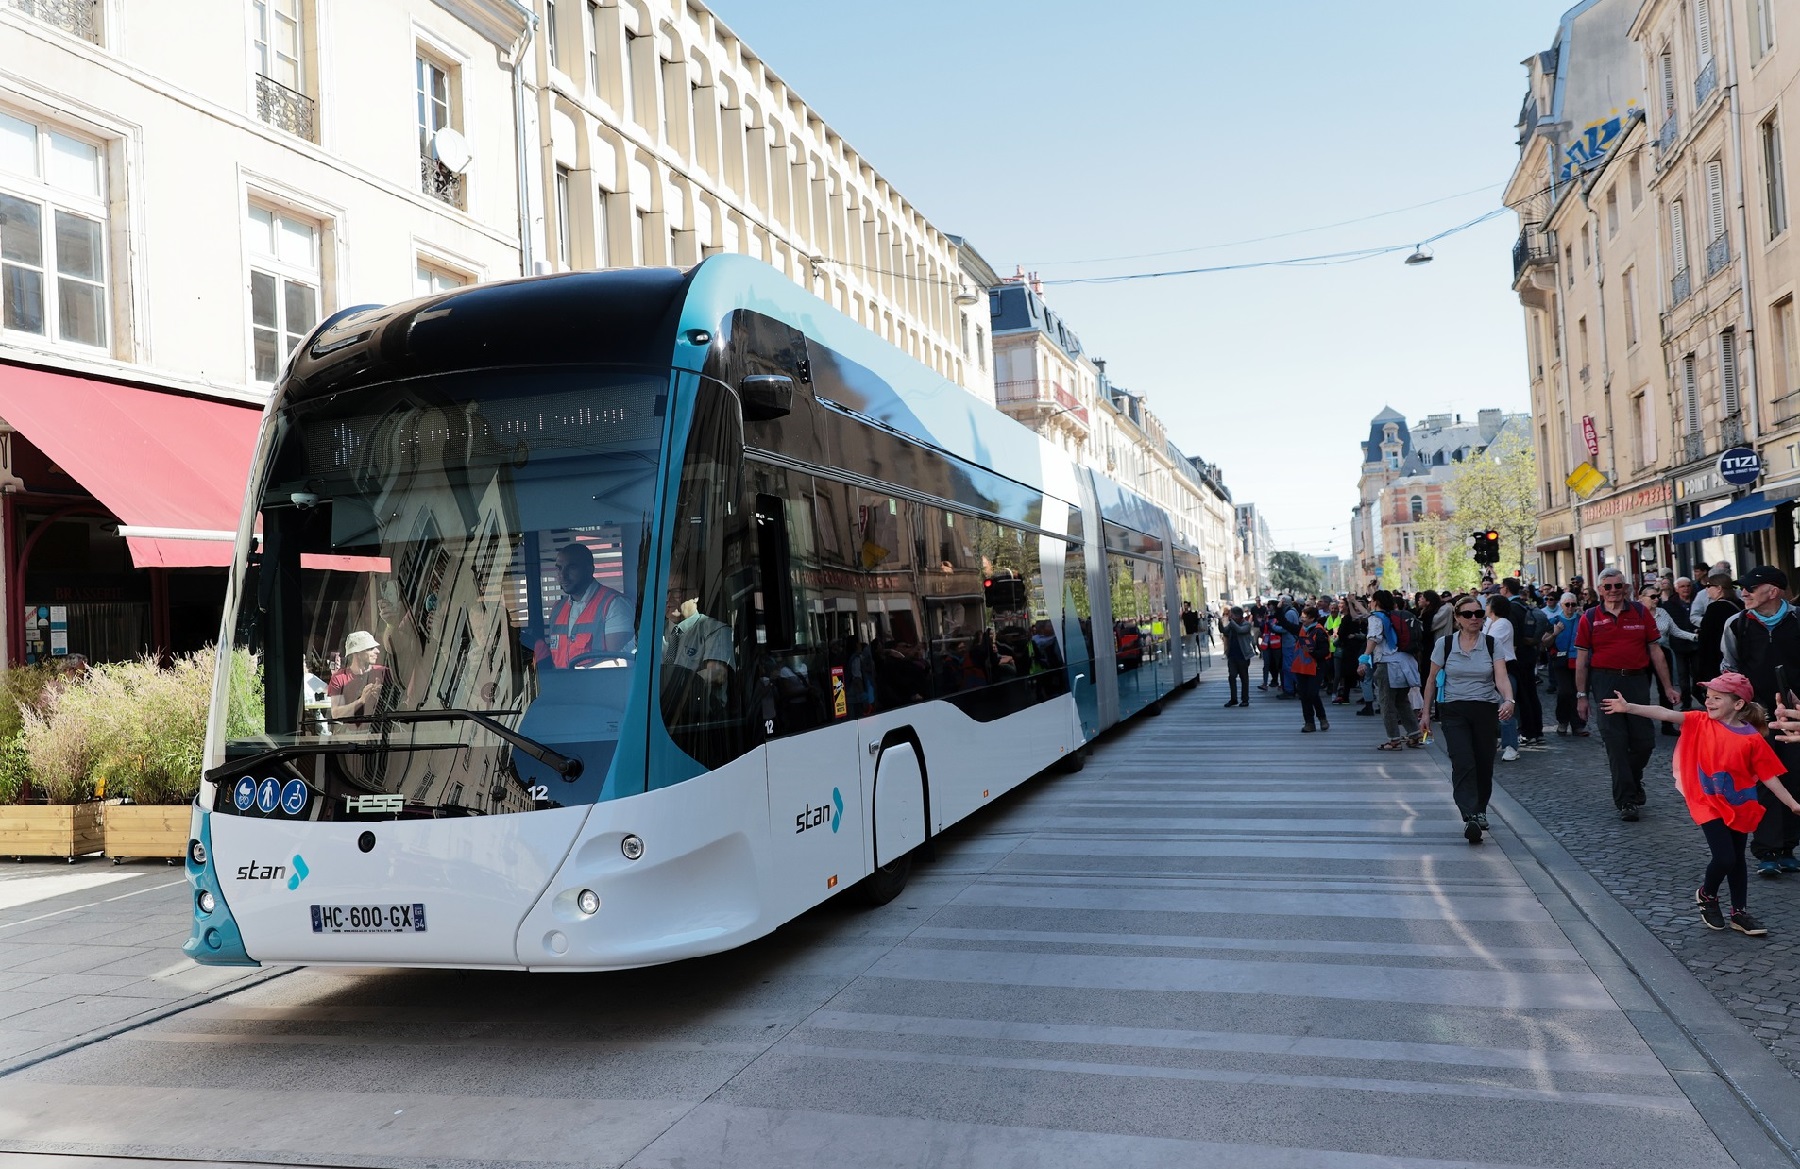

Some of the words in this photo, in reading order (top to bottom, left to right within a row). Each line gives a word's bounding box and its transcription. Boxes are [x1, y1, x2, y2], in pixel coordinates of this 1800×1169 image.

[1583, 416, 1598, 455] TABAC
[1723, 455, 1758, 469] TIZI
[1684, 475, 1709, 496] POINT
[1712, 525, 1723, 536] TIZI
[765, 720, 774, 734] 12
[528, 785, 549, 801] 12
[346, 794, 404, 813] HESS
[796, 803, 831, 834] stan
[236, 860, 287, 880] stan
[322, 905, 413, 928] HC-600-GX
